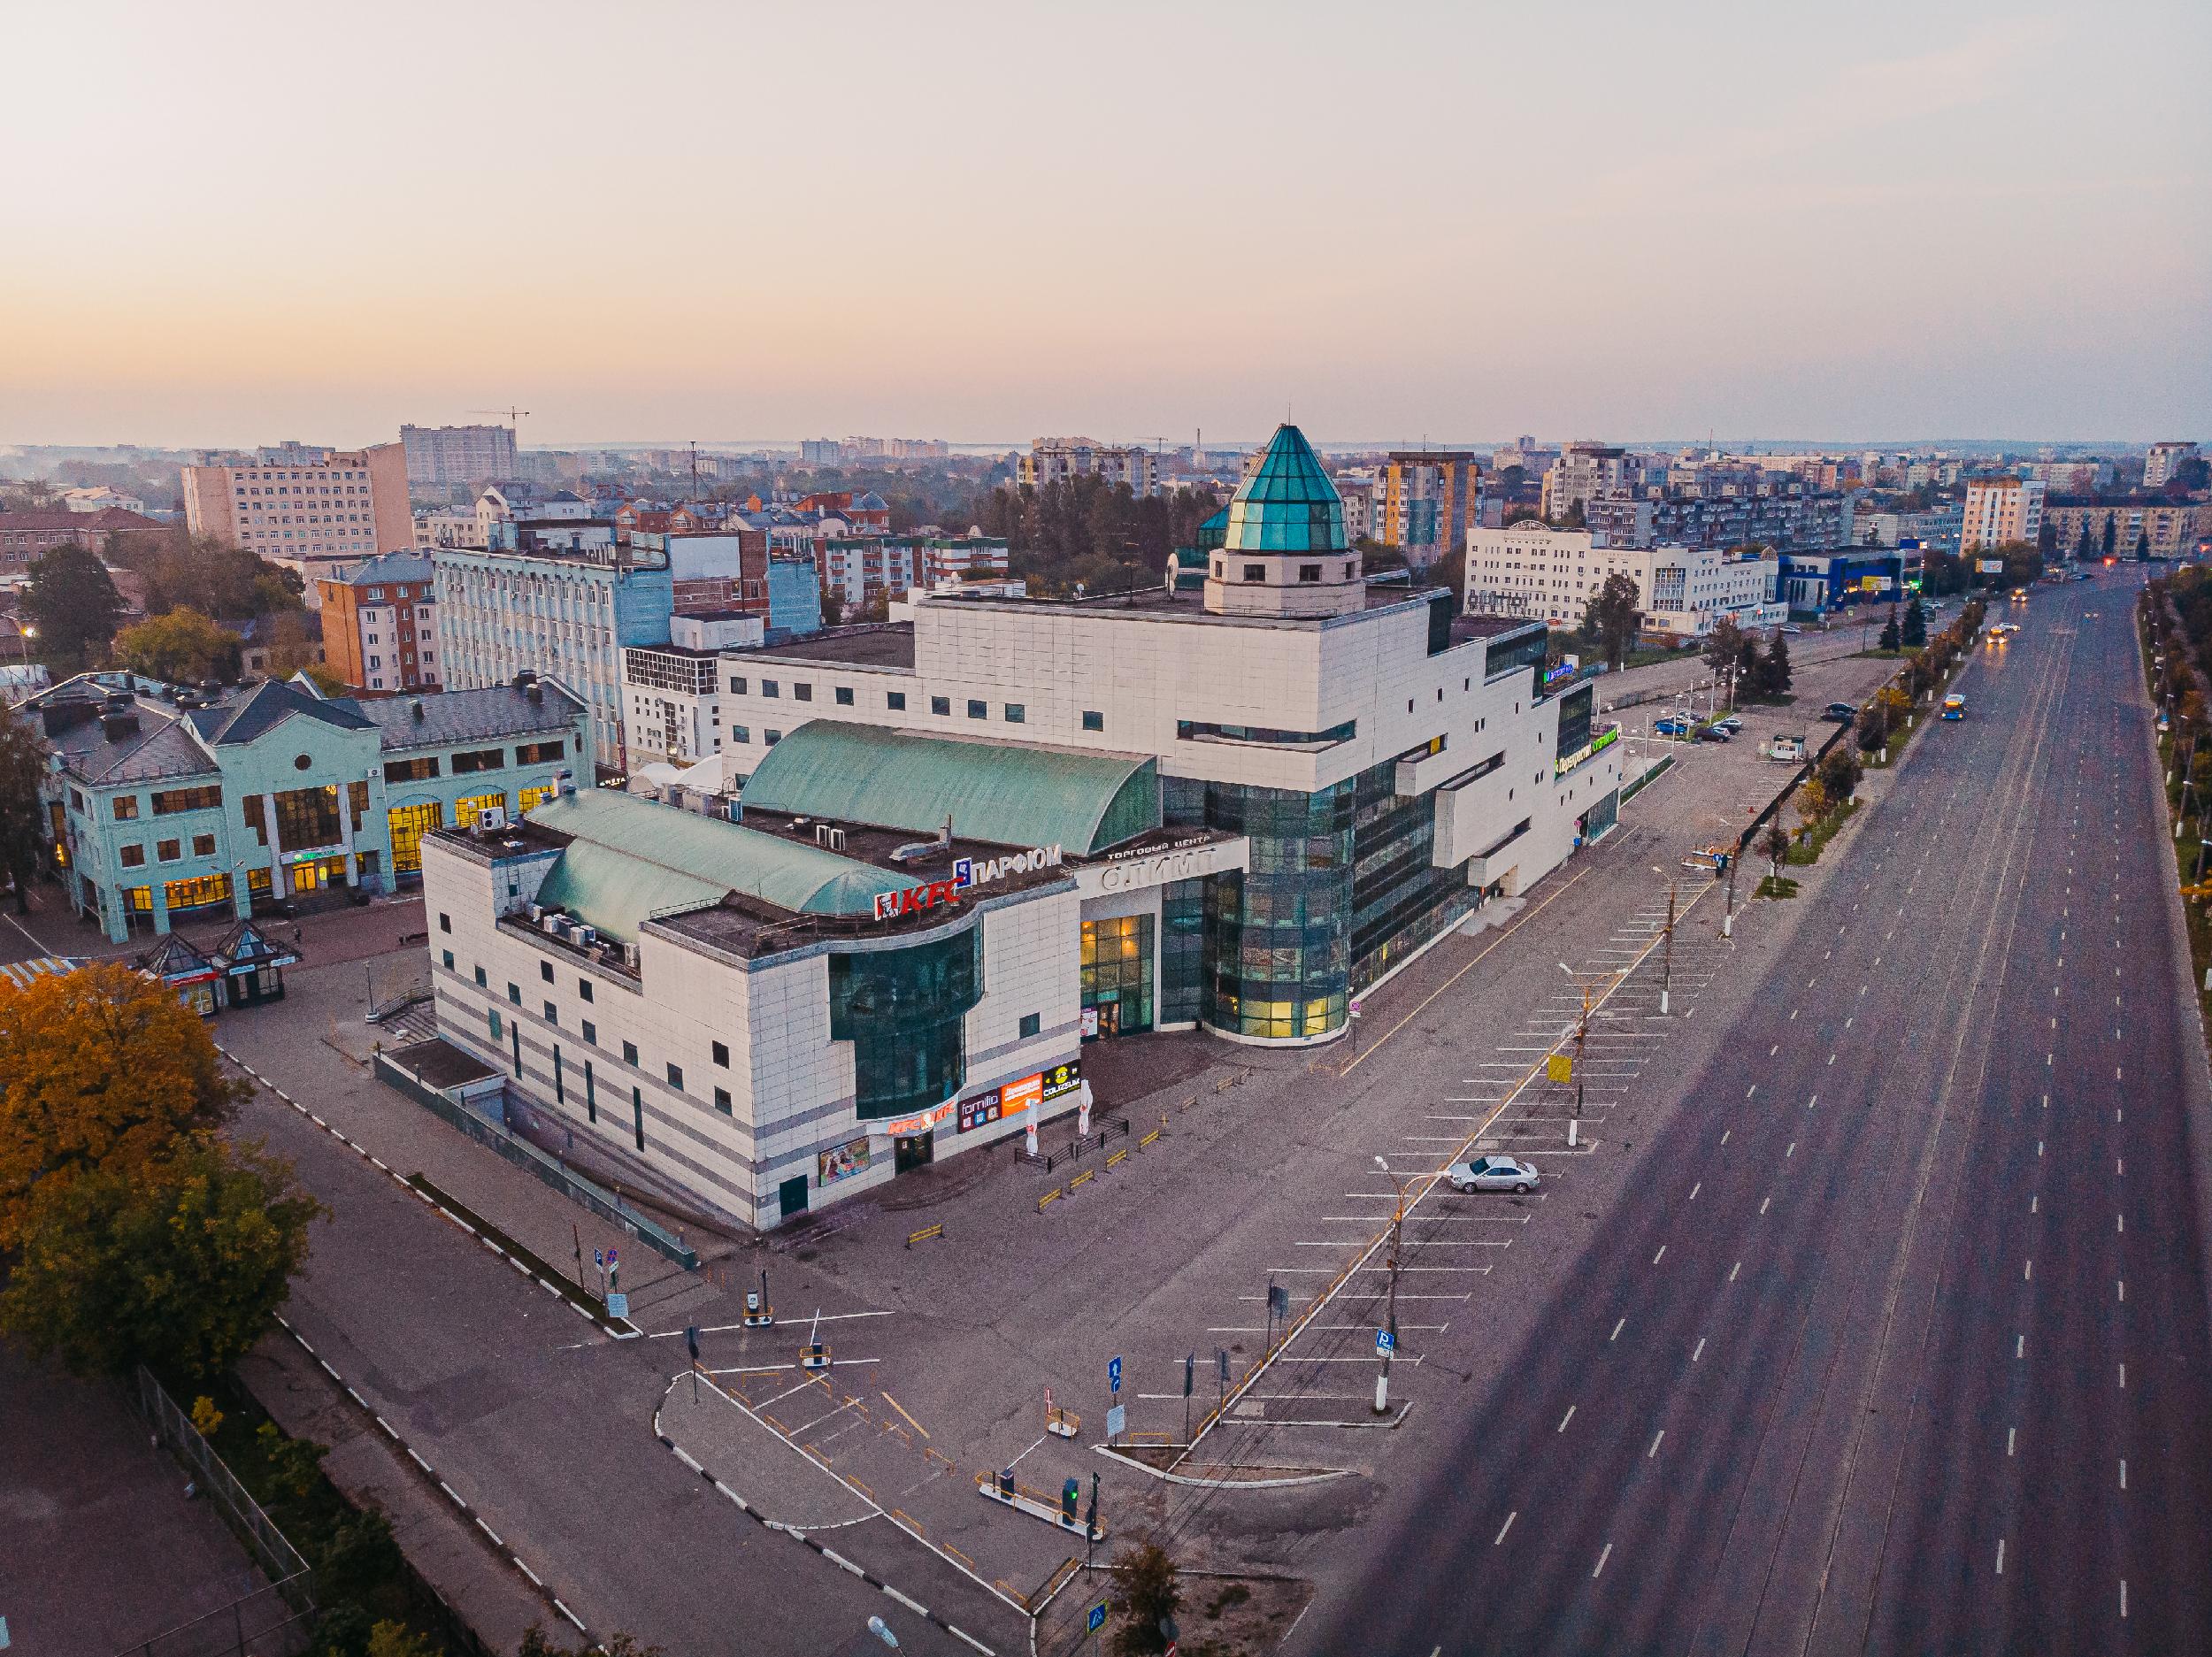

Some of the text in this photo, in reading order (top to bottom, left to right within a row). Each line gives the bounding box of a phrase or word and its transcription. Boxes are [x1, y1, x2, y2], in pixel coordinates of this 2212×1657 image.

[1108, 835, 1210, 860] ТОРГОВЫЙ ЦЕНТР
[972, 844, 1062, 885] ПАРФЮМ
[1102, 848, 1217, 891] ОЛИМП
[900, 877, 964, 915] KFC
[962, 1095, 999, 1116] familia
[887, 1118, 921, 1134] KFC
